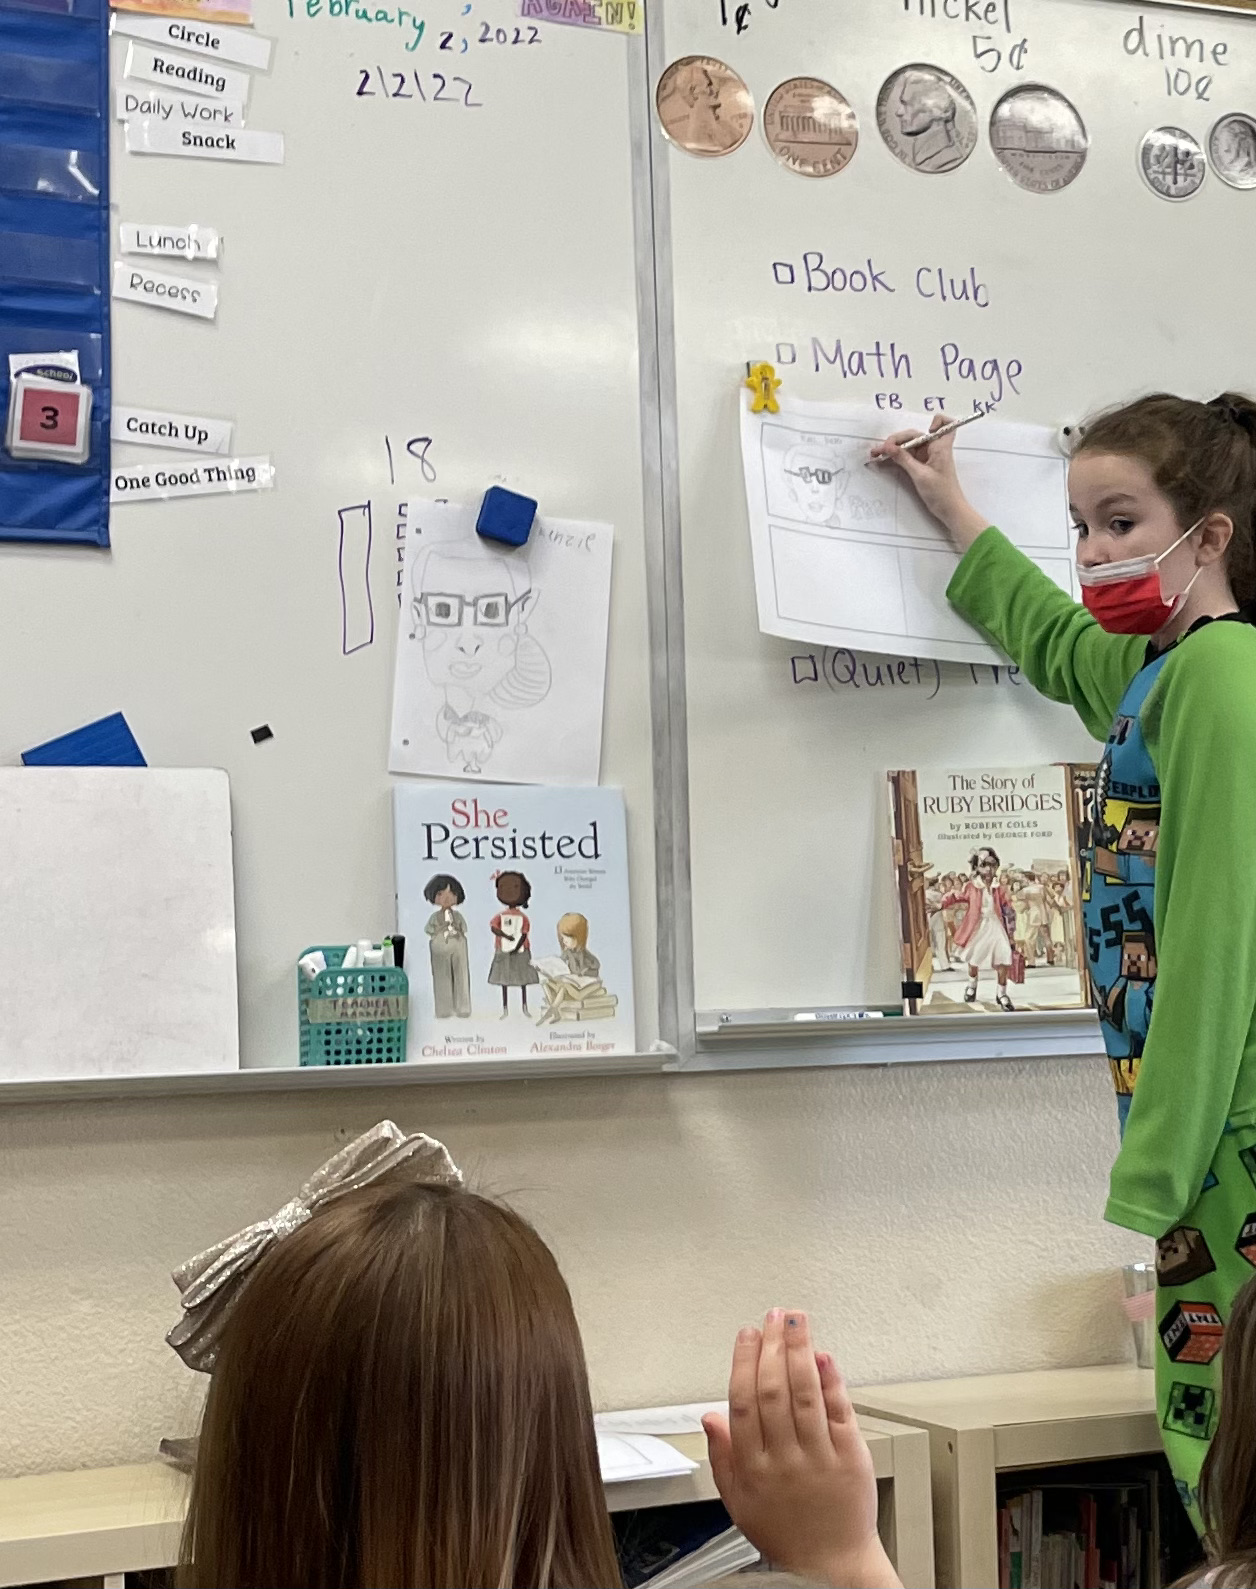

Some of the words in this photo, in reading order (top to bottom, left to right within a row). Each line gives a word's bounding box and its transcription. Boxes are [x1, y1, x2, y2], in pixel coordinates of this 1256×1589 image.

[168, 24, 220, 49] Circle
[478, 22, 543, 45] 2022
[1123, 15, 1228, 66] dime
[972, 35, 1028, 73] 5¢
[153, 58, 226, 92] Reading
[125, 94, 173, 120] Daily
[181, 103, 234, 123] Work
[182, 131, 236, 150] Snack
[136, 230, 201, 251] Lunch
[129, 272, 201, 303] Recess
[803, 251, 896, 293] Book
[916, 266, 990, 307] Club
[811, 336, 912, 378] Math
[940, 342, 1023, 402] Page
[39, 405, 60, 430] 3
[126, 417, 179, 438] Catch
[184, 424, 209, 445] Up
[385, 434, 437, 484] 18
[115, 475, 150, 491] One
[155, 468, 200, 486] Good
[203, 464, 256, 484] Thing
[947, 774, 977, 791] The
[981, 773, 1018, 794] Story
[1021, 773, 1036, 789] of
[451, 797, 509, 829] She
[923, 795, 974, 815] RUBY
[979, 792, 1063, 813] BRIDGES
[950, 822, 961, 832] by
[964, 821, 1003, 830] ROBERT
[1006, 820, 1039, 829] COLES
[421, 820, 602, 861] Persisted
